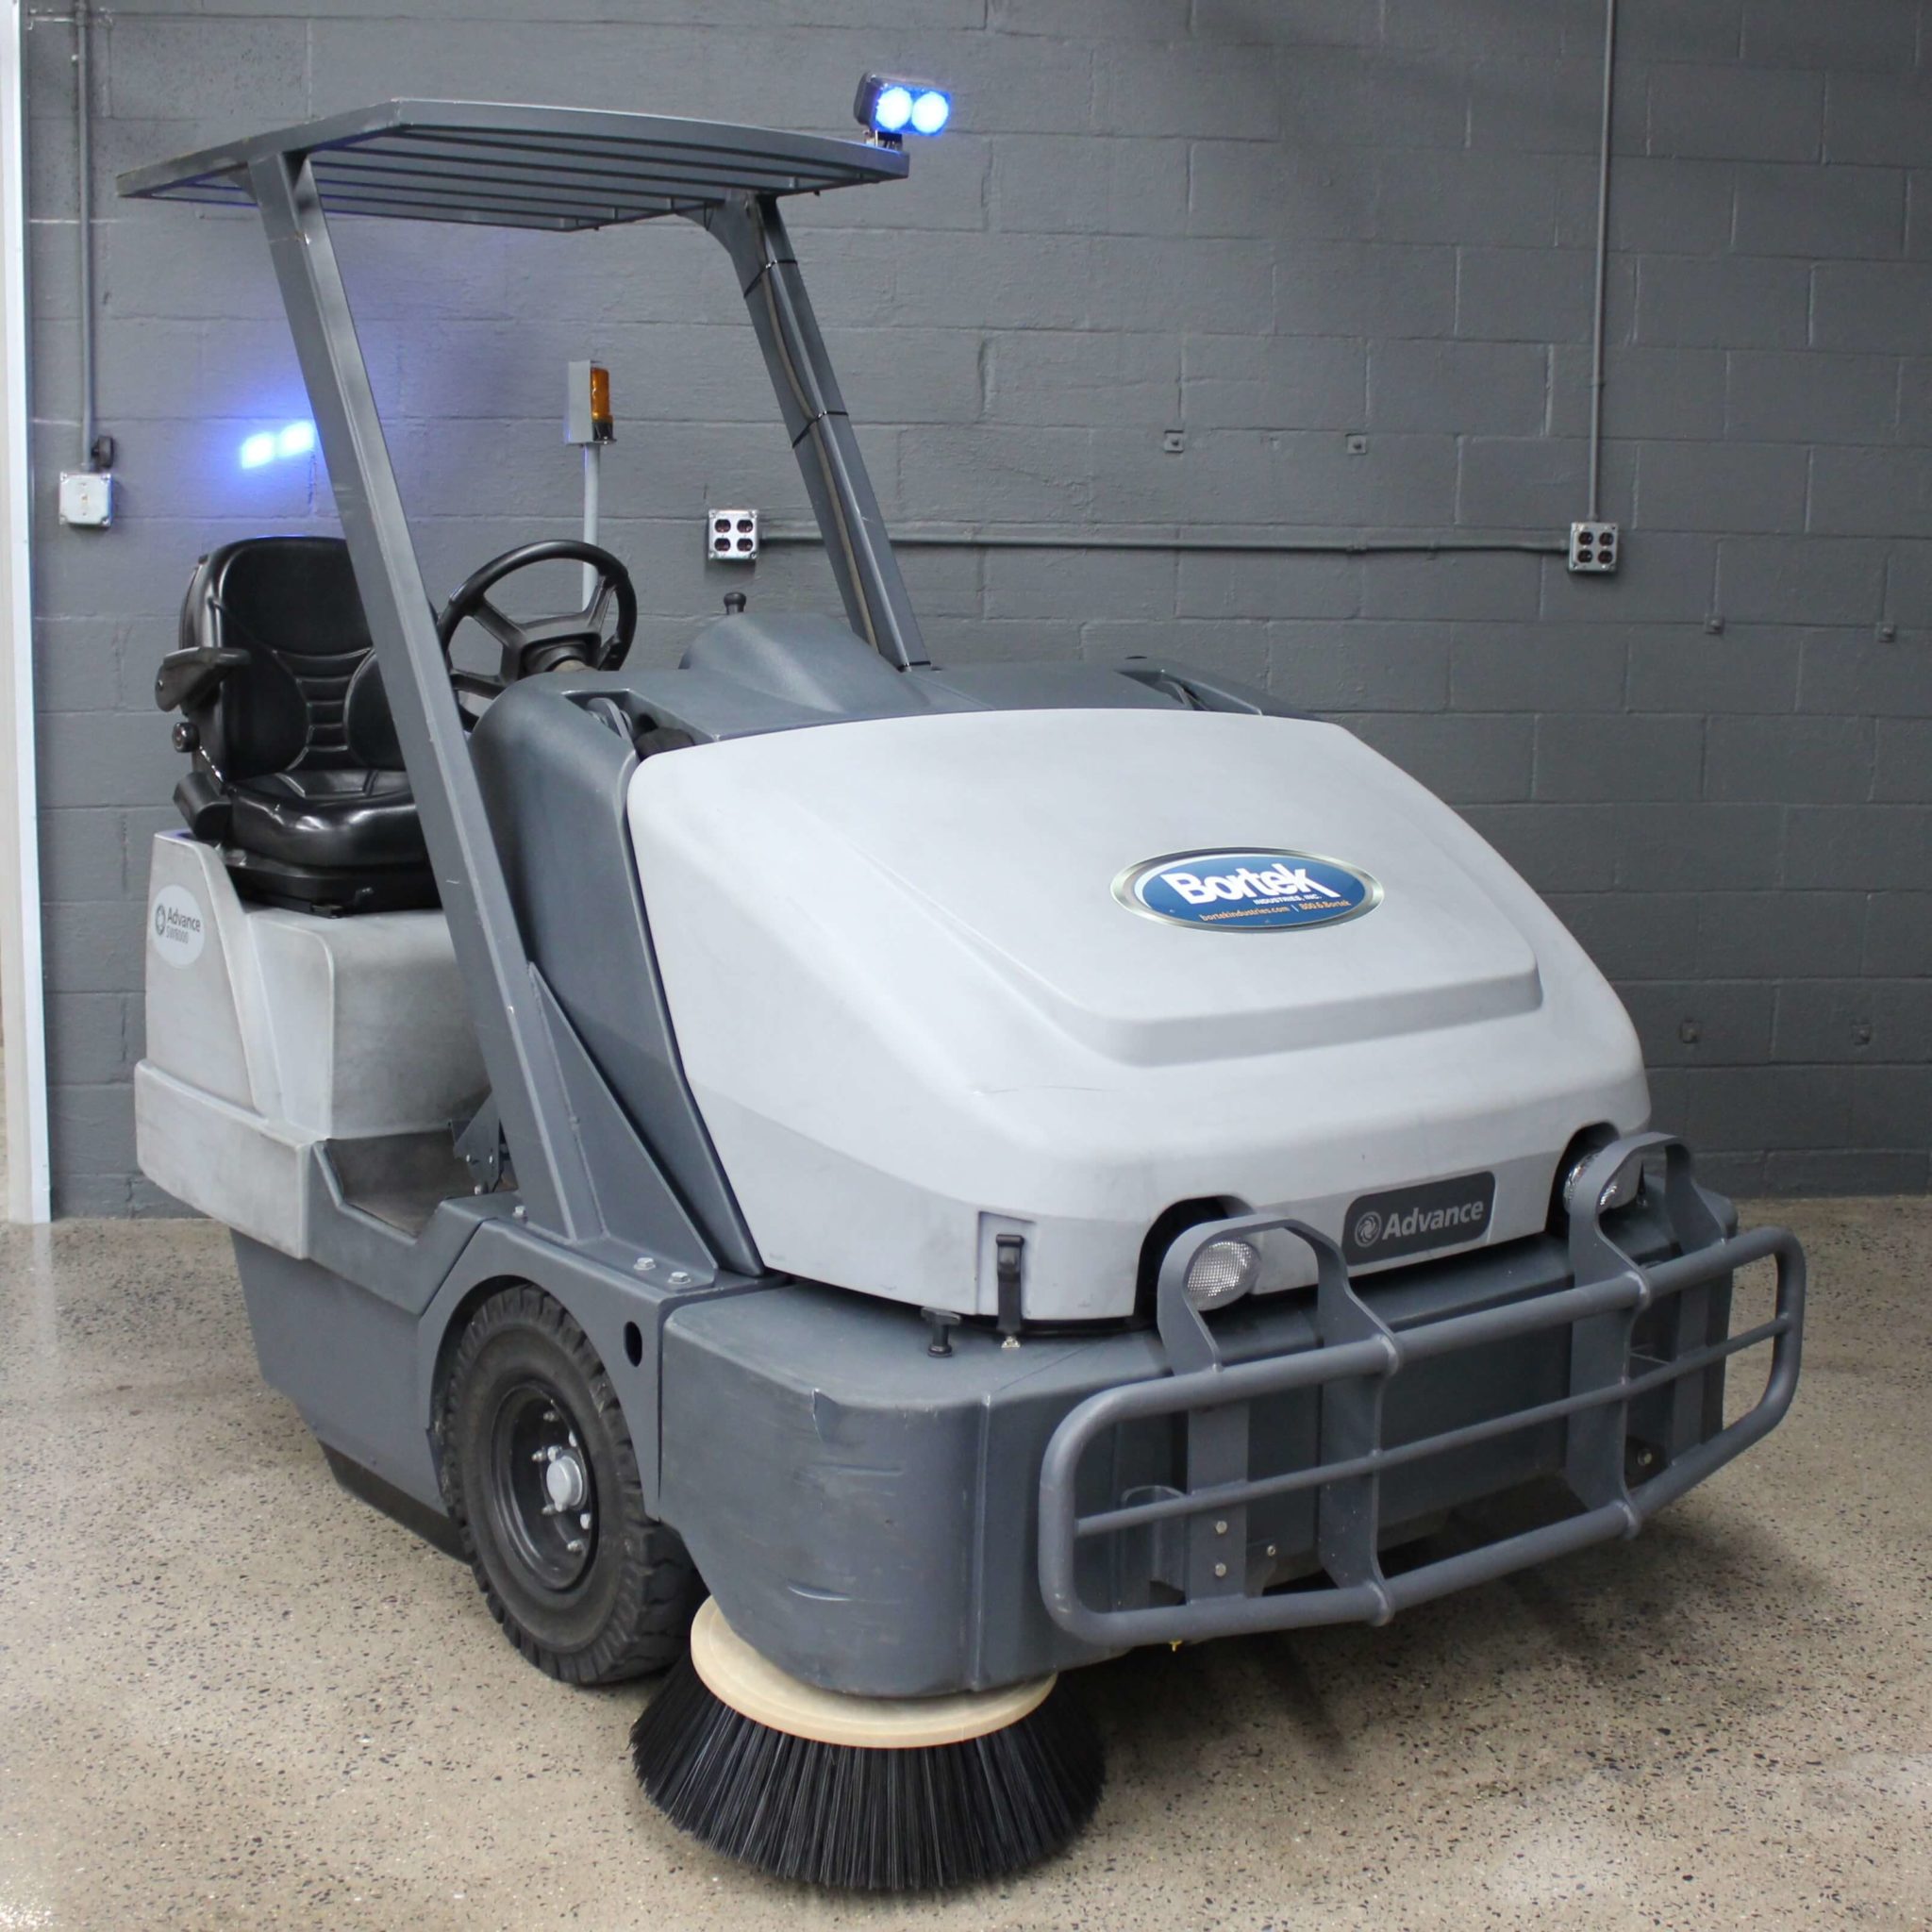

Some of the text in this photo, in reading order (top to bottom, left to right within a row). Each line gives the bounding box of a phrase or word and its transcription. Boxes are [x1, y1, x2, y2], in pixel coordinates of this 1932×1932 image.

[1160, 863, 1341, 904] Bortek
[167, 907, 201, 933] Advance
[1200, 906, 1291, 922] bortekindustries.com
[1382, 1201, 1483, 1241] Advance
